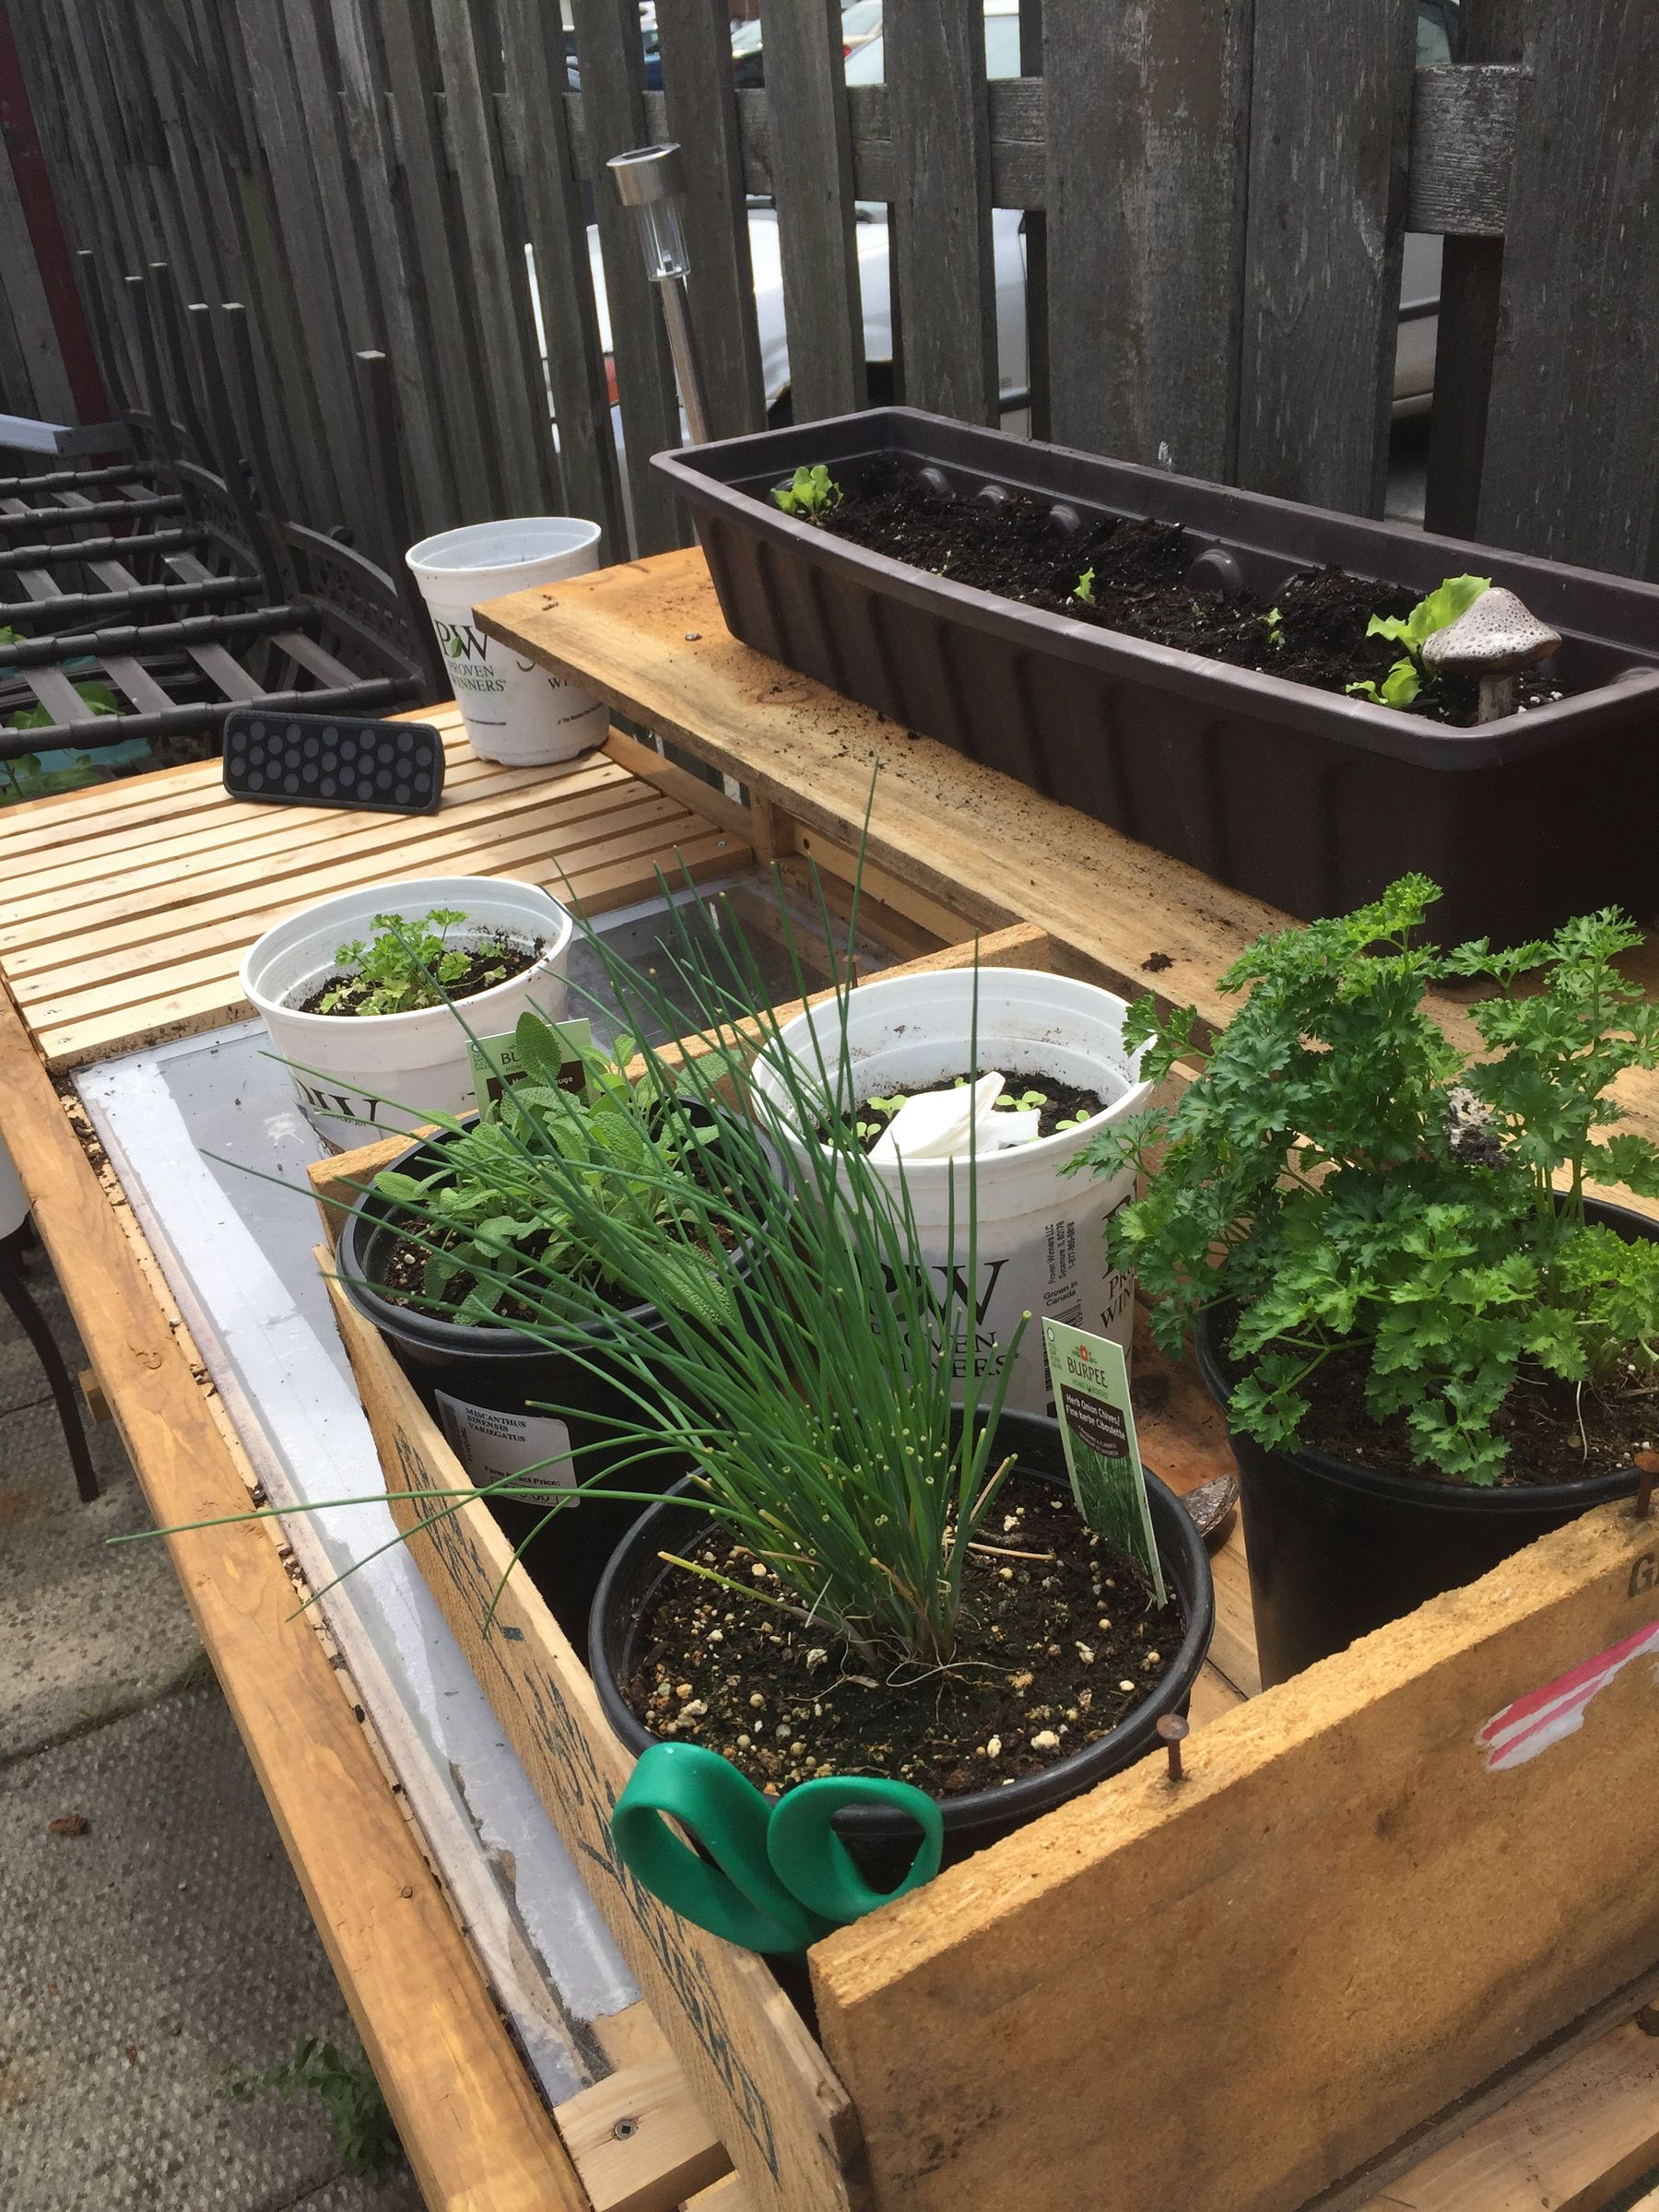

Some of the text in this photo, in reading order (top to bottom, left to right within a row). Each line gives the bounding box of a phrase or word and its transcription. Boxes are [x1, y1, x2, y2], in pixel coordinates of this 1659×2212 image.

[1043, 1285, 1069, 1300] Grown
[1046, 1290, 1077, 1307] Canada
[1066, 1356, 1108, 1389] BURPEE
[465, 1406, 527, 1428] MISCANTHUS
